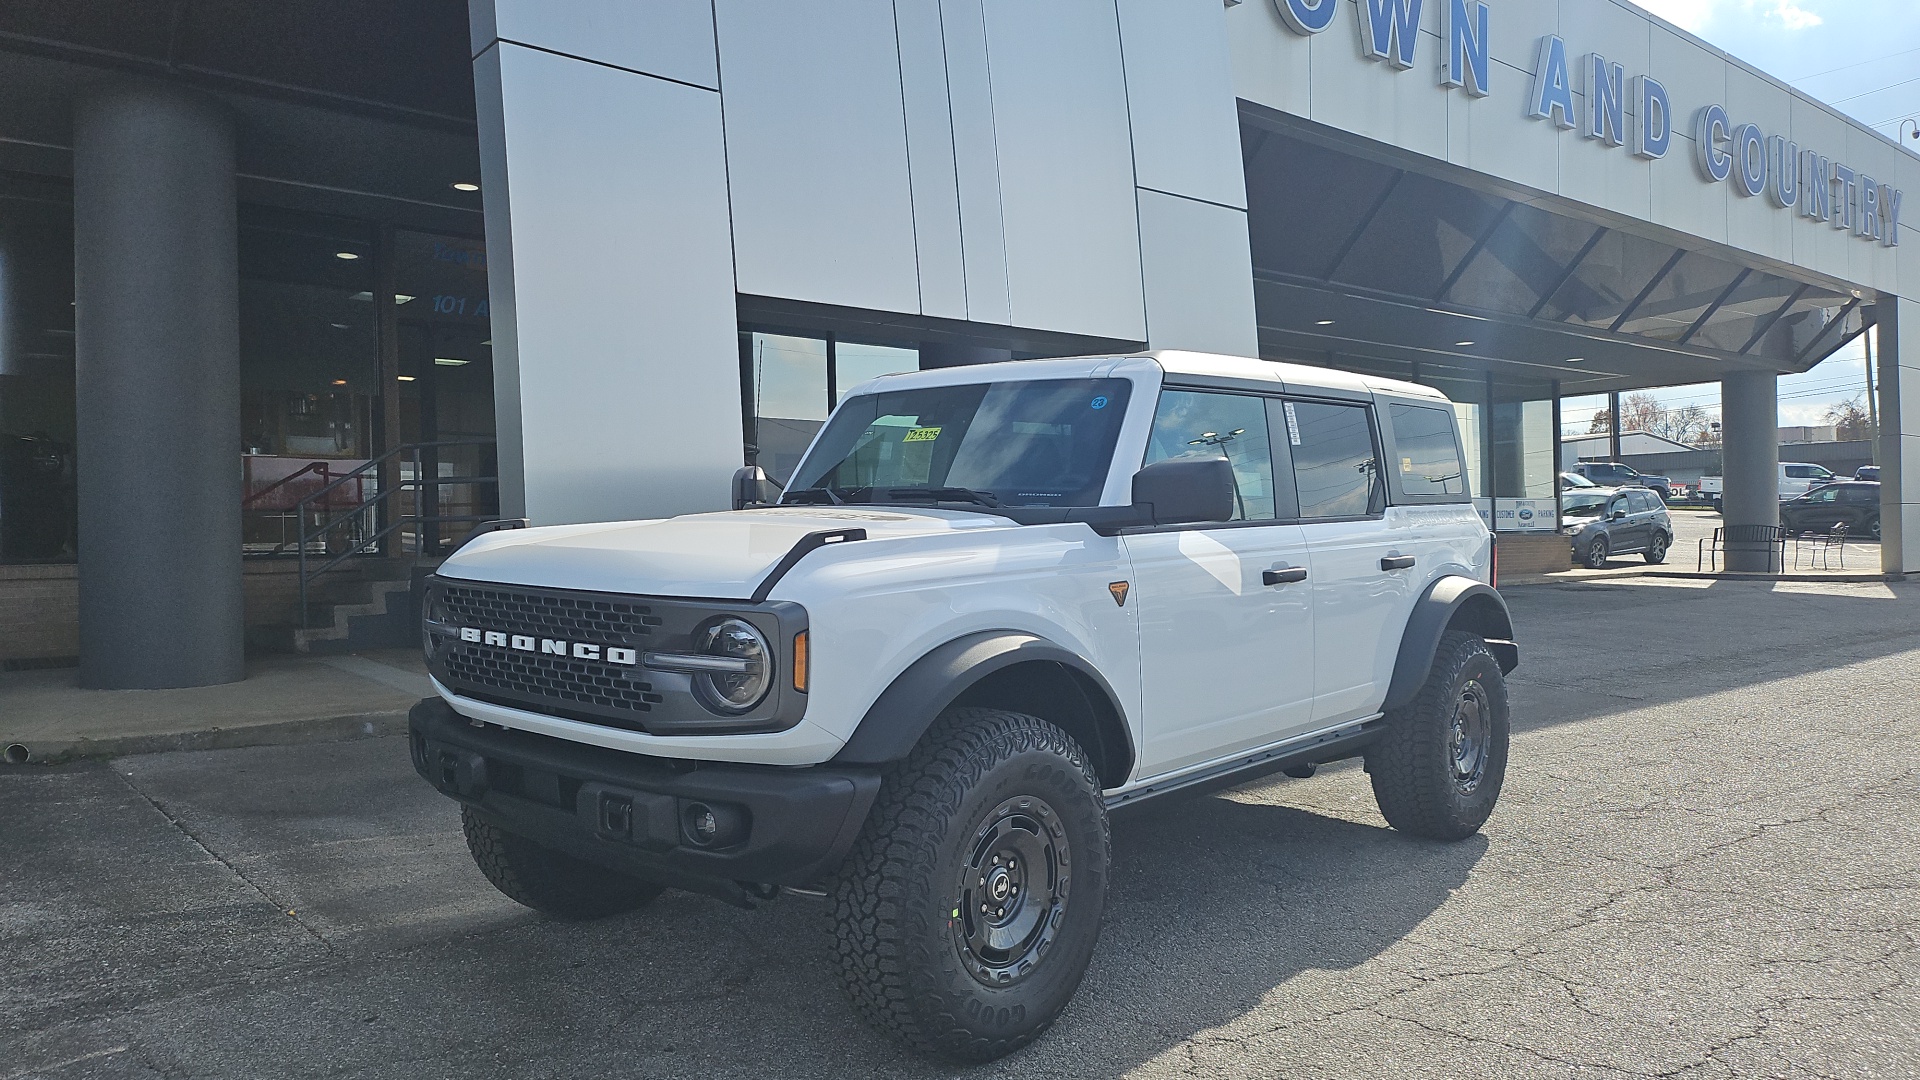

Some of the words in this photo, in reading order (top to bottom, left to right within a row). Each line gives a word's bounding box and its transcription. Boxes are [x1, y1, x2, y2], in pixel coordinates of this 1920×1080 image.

[1529, 33, 1671, 160] AND
[1696, 103, 1903, 248] COUNTRY
[433, 294, 466, 315] 101
[1497, 510, 1514, 518] CUSTOMER
[1538, 510, 1554, 518] PARKING
[461, 627, 636, 666] BRONCO
